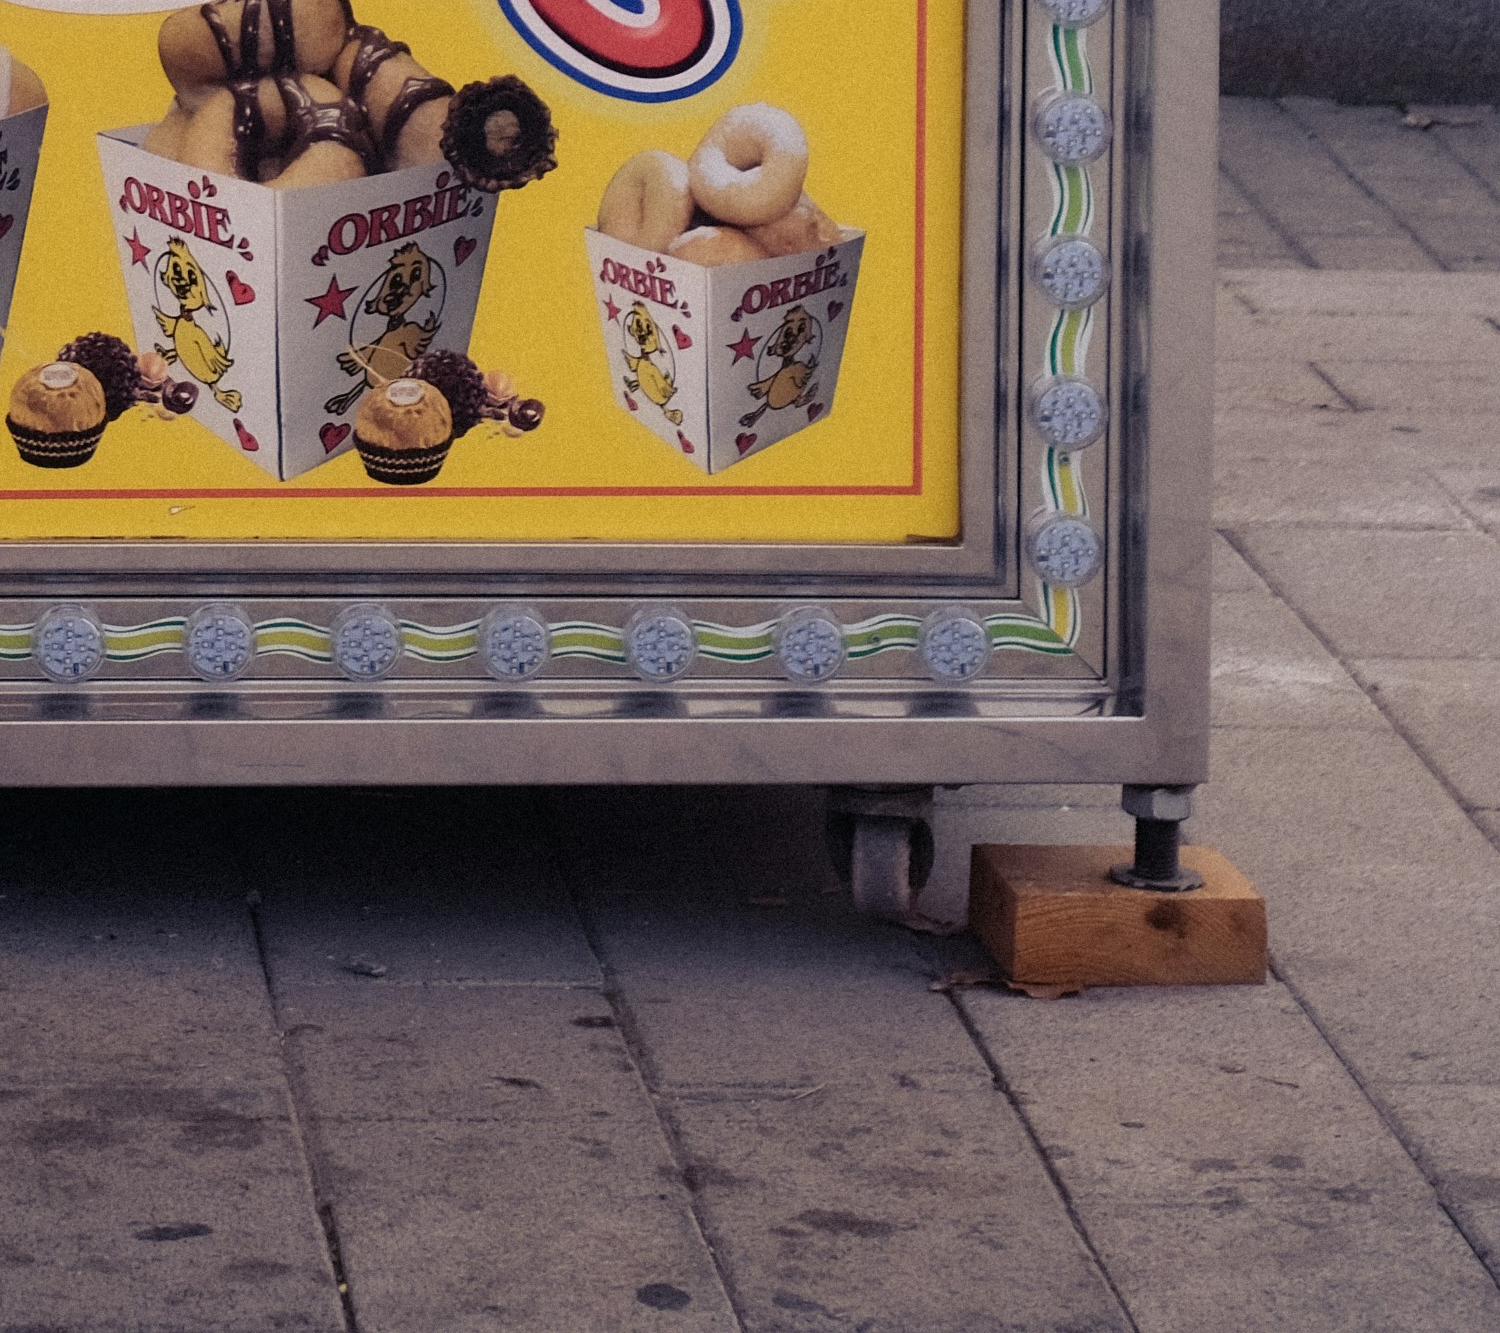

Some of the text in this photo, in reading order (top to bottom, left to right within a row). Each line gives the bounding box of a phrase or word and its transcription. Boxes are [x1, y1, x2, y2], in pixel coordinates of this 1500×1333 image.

[124, 176, 234, 249] ORBIE
[328, 171, 472, 255] ORBIE
[602, 257, 678, 309] ORBIE
[742, 254, 840, 314] ORBIE
